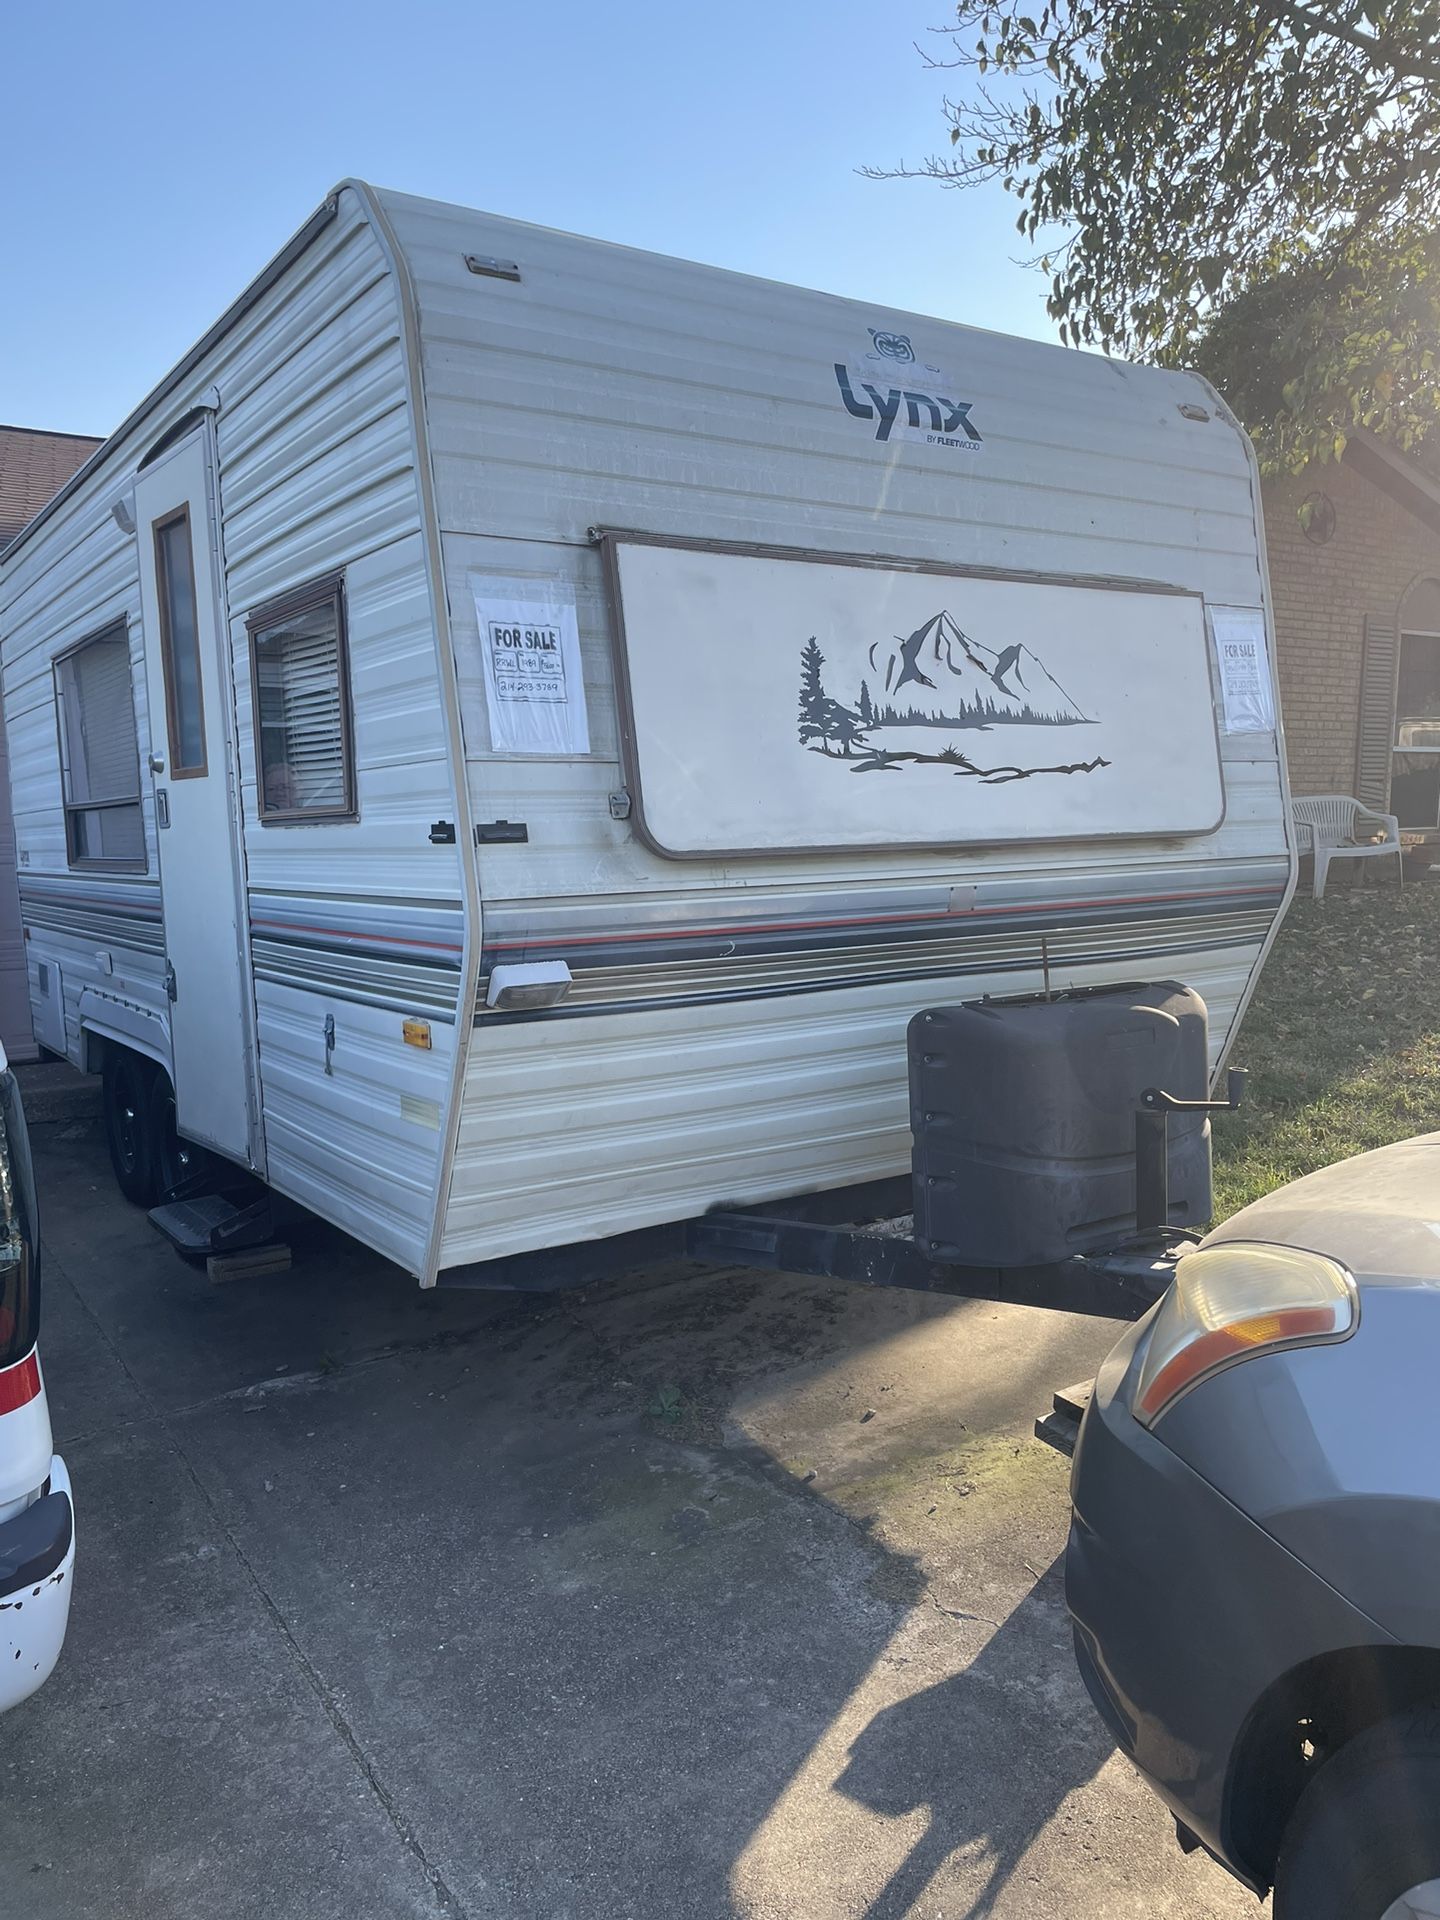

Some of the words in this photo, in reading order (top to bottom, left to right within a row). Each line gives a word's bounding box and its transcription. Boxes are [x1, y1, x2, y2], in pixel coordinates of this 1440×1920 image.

[834, 363, 983, 442] Lynx
[927, 435, 937, 444] BY
[938, 437, 980, 451] FLEETWOOD
[494, 628, 522, 648] FOR
[525, 630, 557, 650] SALE
[1224, 645, 1238, 658] FOR
[1239, 644, 1255, 657] SALE
